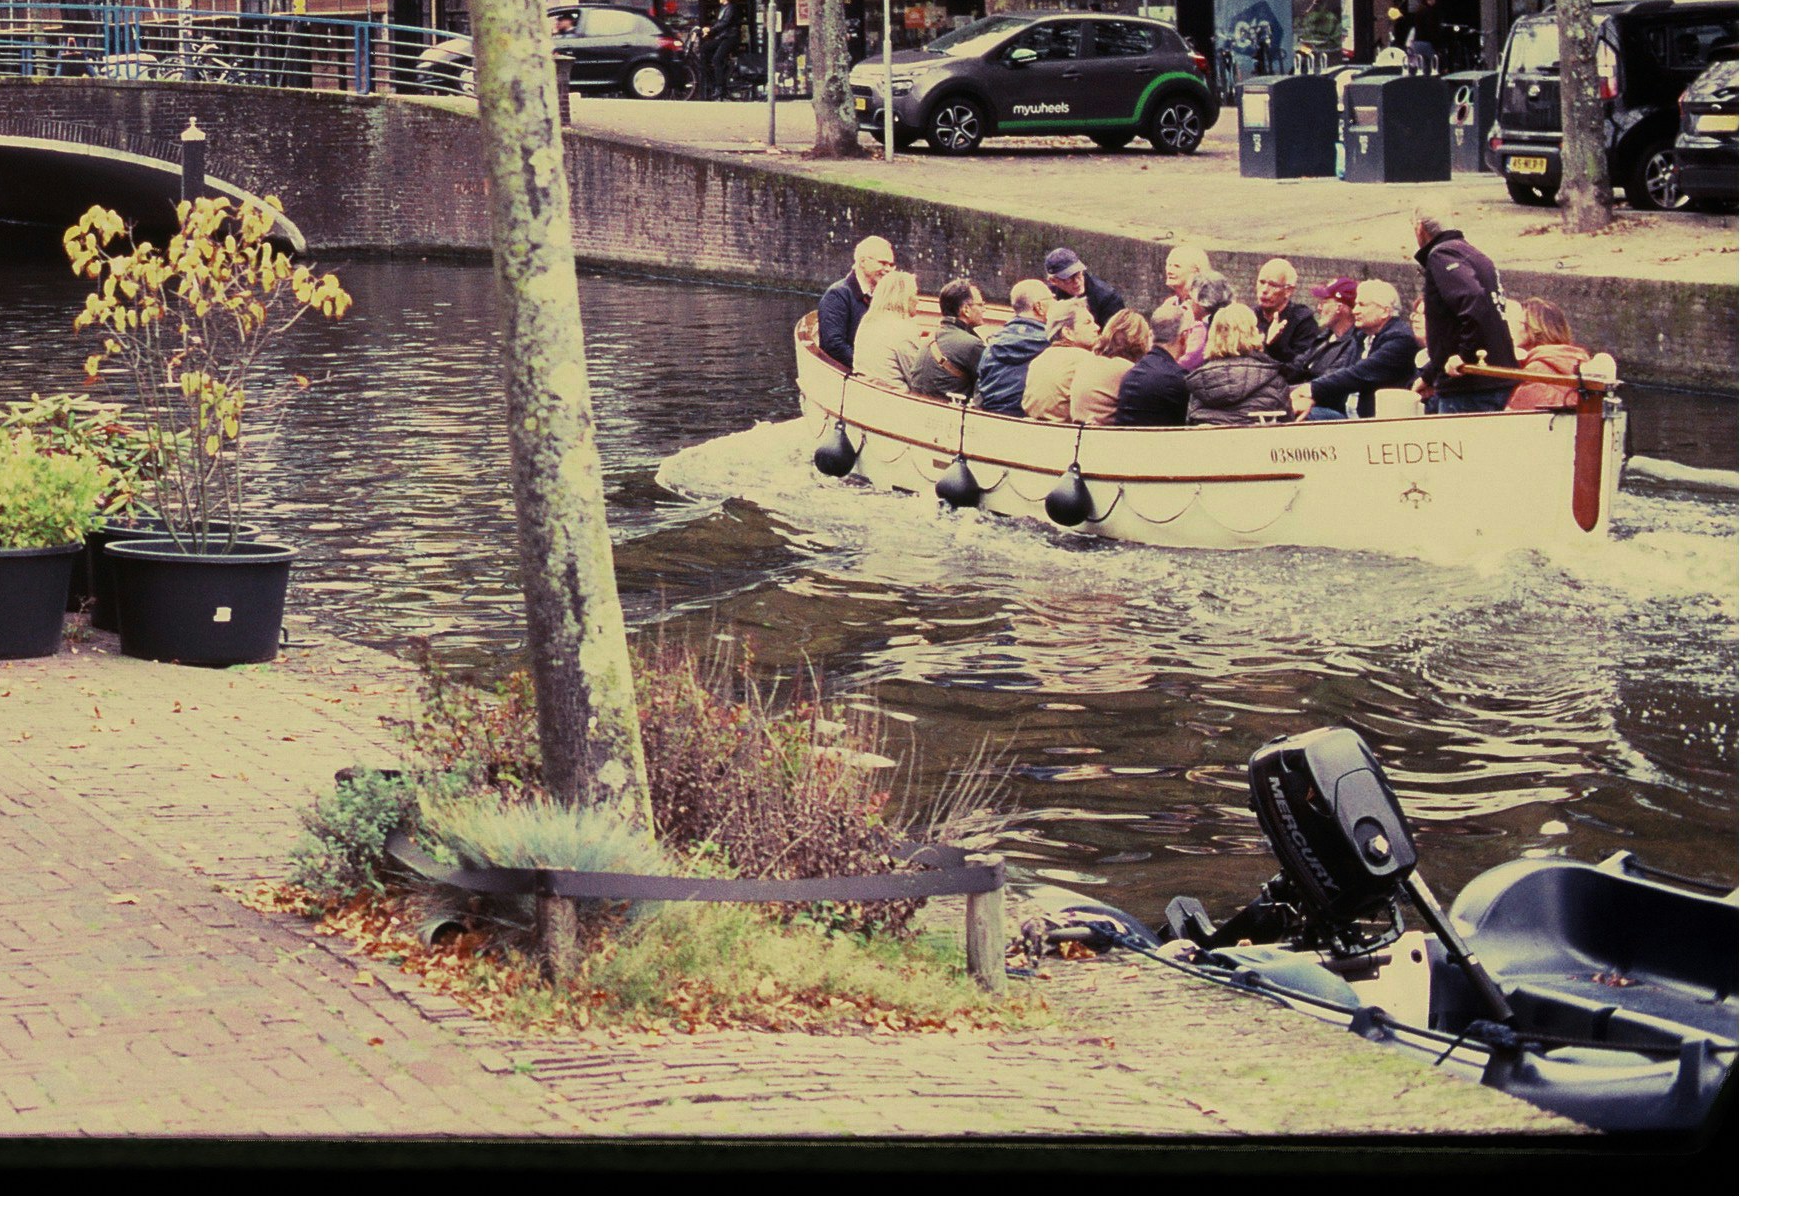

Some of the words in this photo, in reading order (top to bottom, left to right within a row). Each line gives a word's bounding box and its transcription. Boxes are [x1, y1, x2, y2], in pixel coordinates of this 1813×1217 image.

[1013, 102, 1070, 116] mywheels
[1270, 445, 1338, 464] 03800683
[1367, 441, 1463, 464] LEIDEN
[1268, 776, 1340, 891] MERCURY
